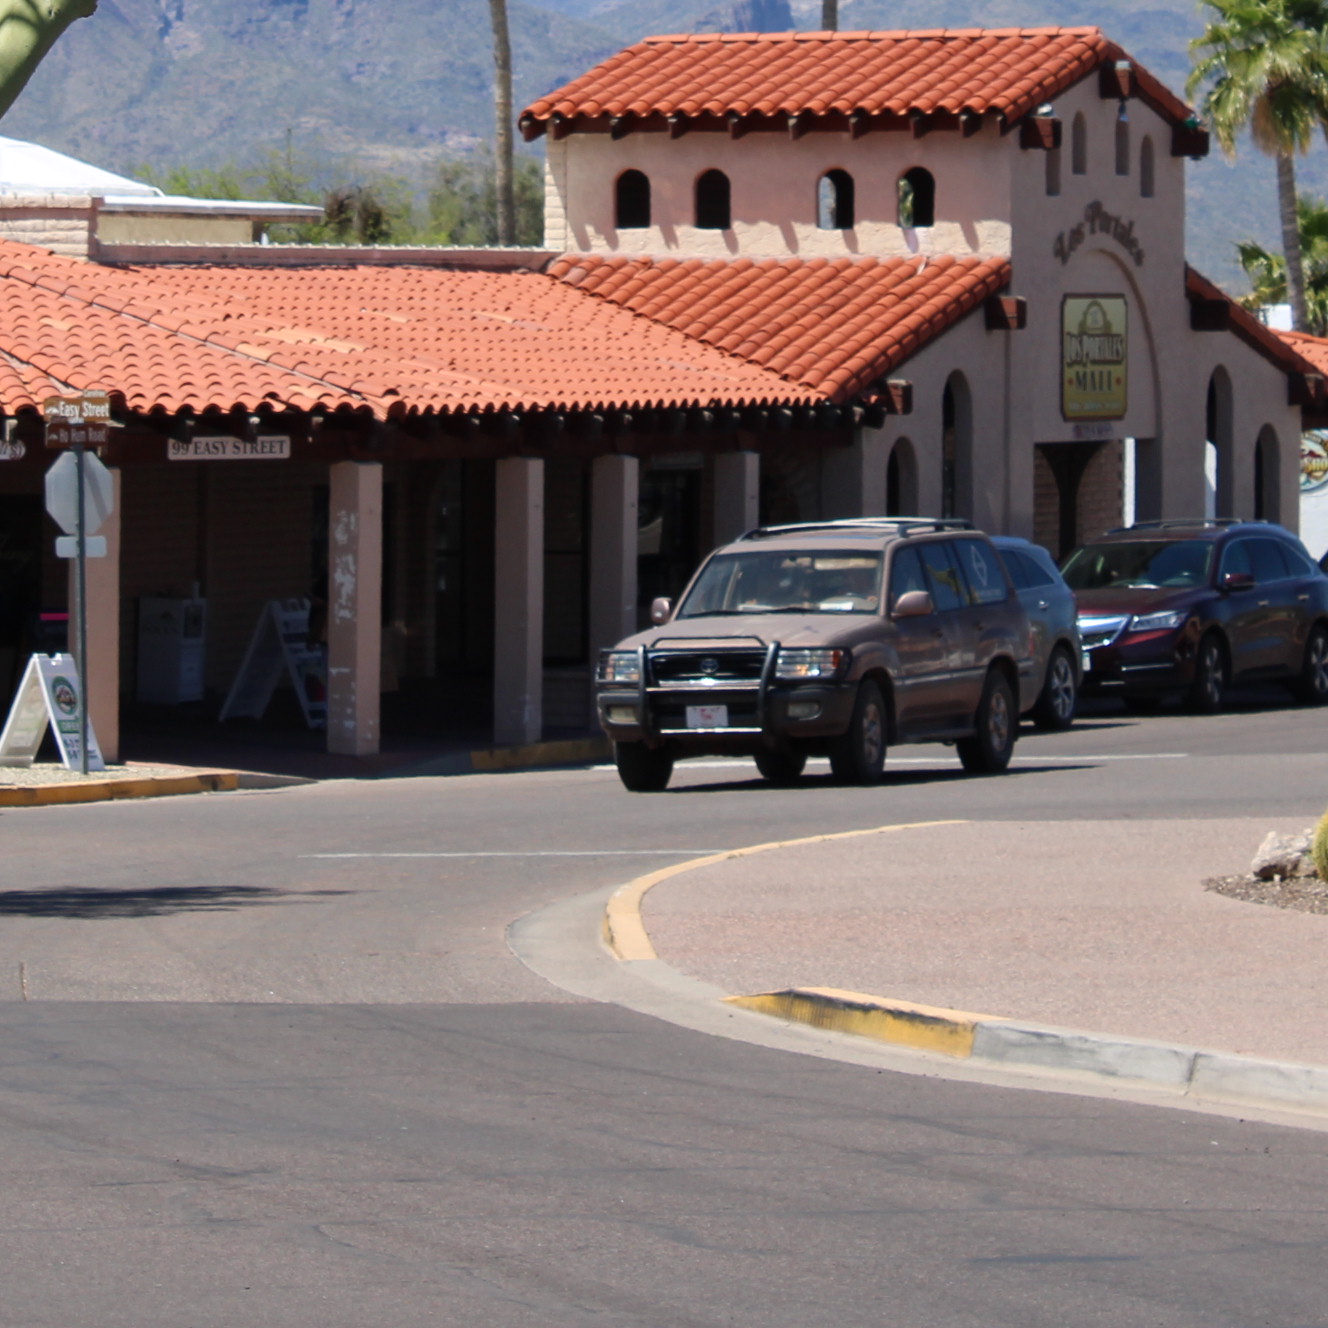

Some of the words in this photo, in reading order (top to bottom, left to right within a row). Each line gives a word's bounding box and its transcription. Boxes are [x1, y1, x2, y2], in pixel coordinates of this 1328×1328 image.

[1075, 370, 1113, 392] MALL
[59, 401, 80, 419] Easy
[82, 401, 110, 417] Street
[172, 441, 190, 455] 99
[194, 440, 229, 455] EASY
[232, 440, 286, 454] STREET
